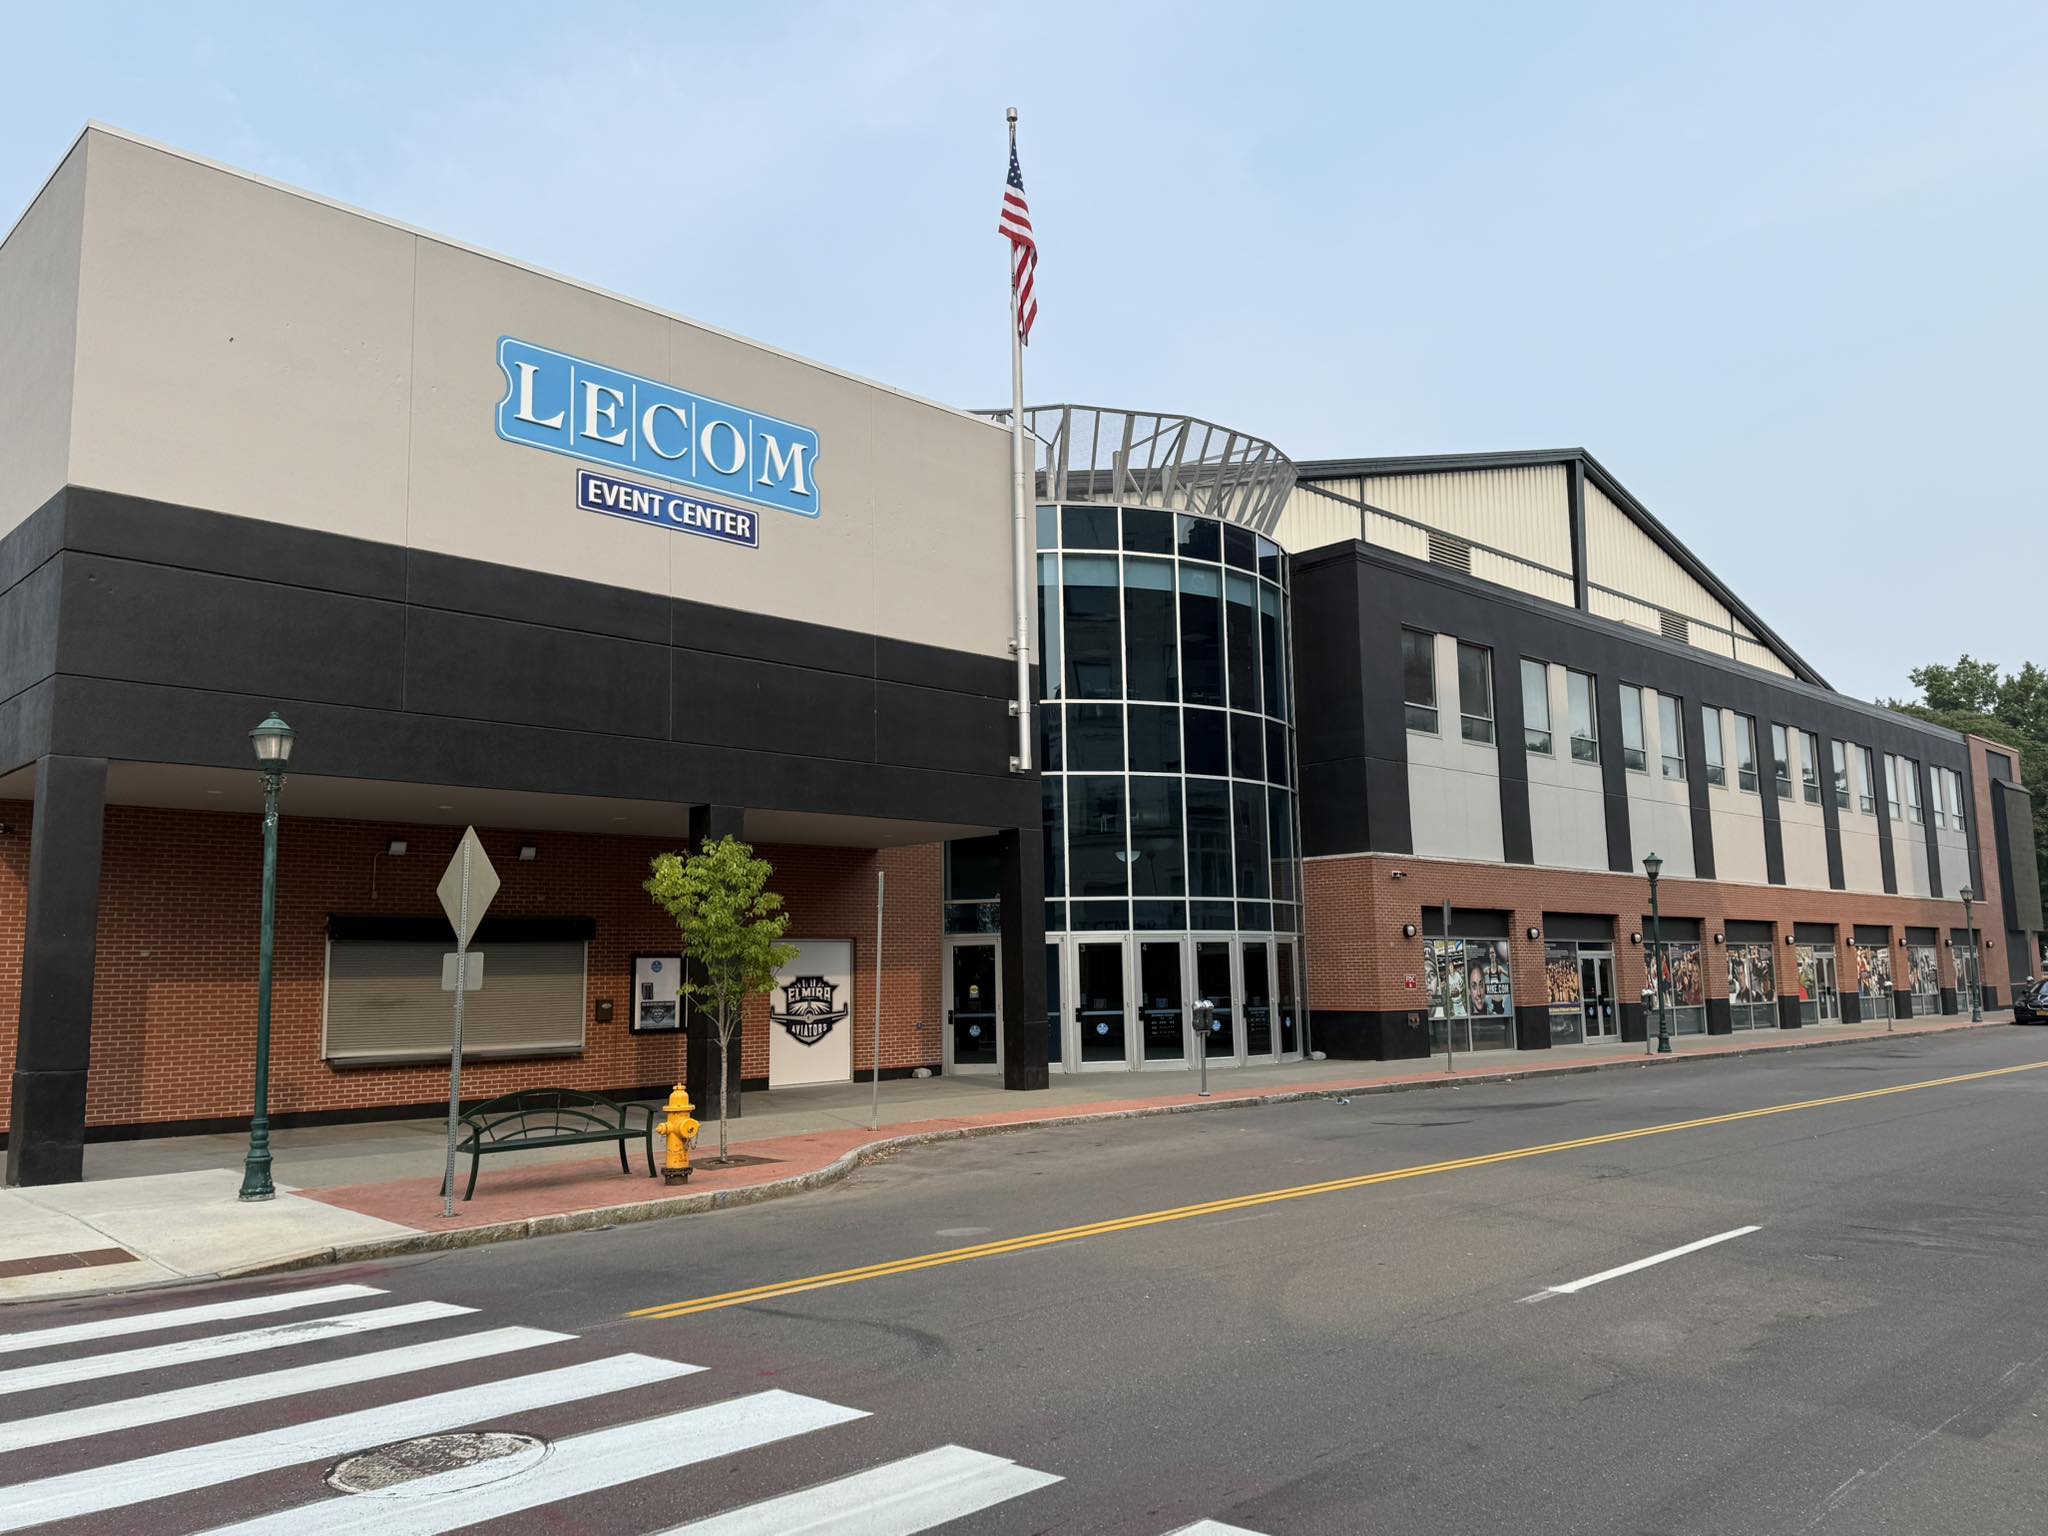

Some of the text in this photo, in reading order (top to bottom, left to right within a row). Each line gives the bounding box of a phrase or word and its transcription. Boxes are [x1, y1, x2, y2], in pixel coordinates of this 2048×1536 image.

[513, 361, 811, 496] LECOM
[588, 478, 751, 538] EVENT CENTER
[788, 987, 832, 1002] ELMIRA
[791, 1023, 827, 1036] AVIATORS
